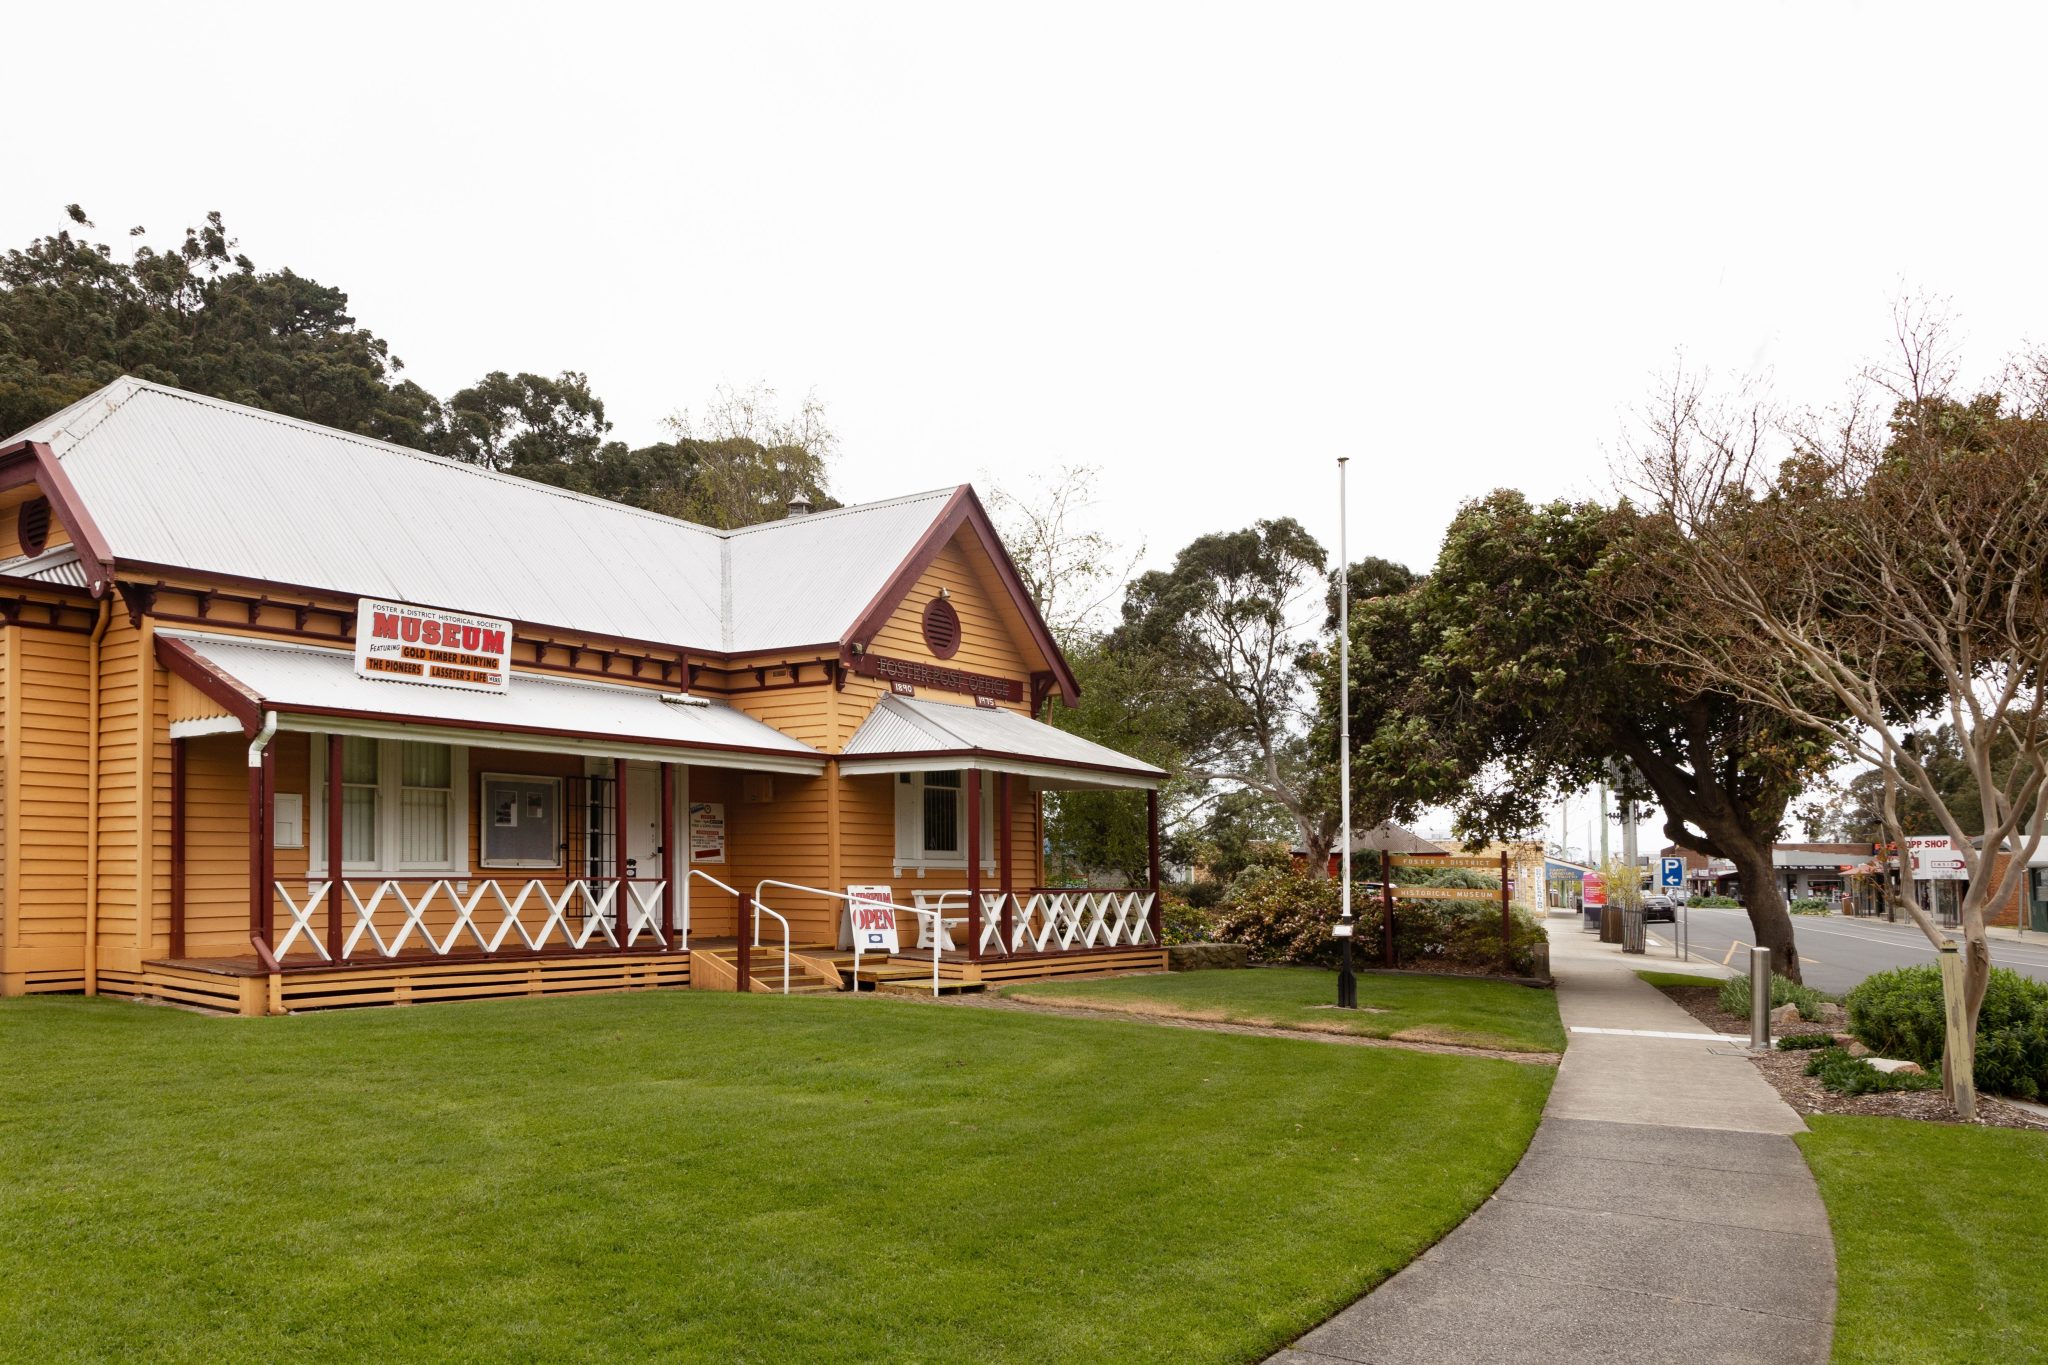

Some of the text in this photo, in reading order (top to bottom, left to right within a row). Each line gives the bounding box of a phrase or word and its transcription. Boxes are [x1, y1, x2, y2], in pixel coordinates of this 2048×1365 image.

[372, 603, 398, 613] FOSTER
[407, 609, 436, 619] DISTRICT
[438, 614, 474, 626] HISTORICAL
[476, 620, 503, 629] SOCIETY
[372, 611, 506, 655] MUSEUM
[403, 646, 498, 668] GOLD TIMBER DAIRYING
[368, 658, 421, 674] THE PIONEERS
[431, 668, 487, 682] LASSETER'S LIFE
[880, 659, 1010, 696] FOSTER POST OFFICE
[895, 683, 913, 693] 1890
[978, 696, 994, 706] 1975
[1924, 840, 1949, 848] SHOP
[1665, 860, 1679, 874] P
[853, 909, 895, 929] OPEN
